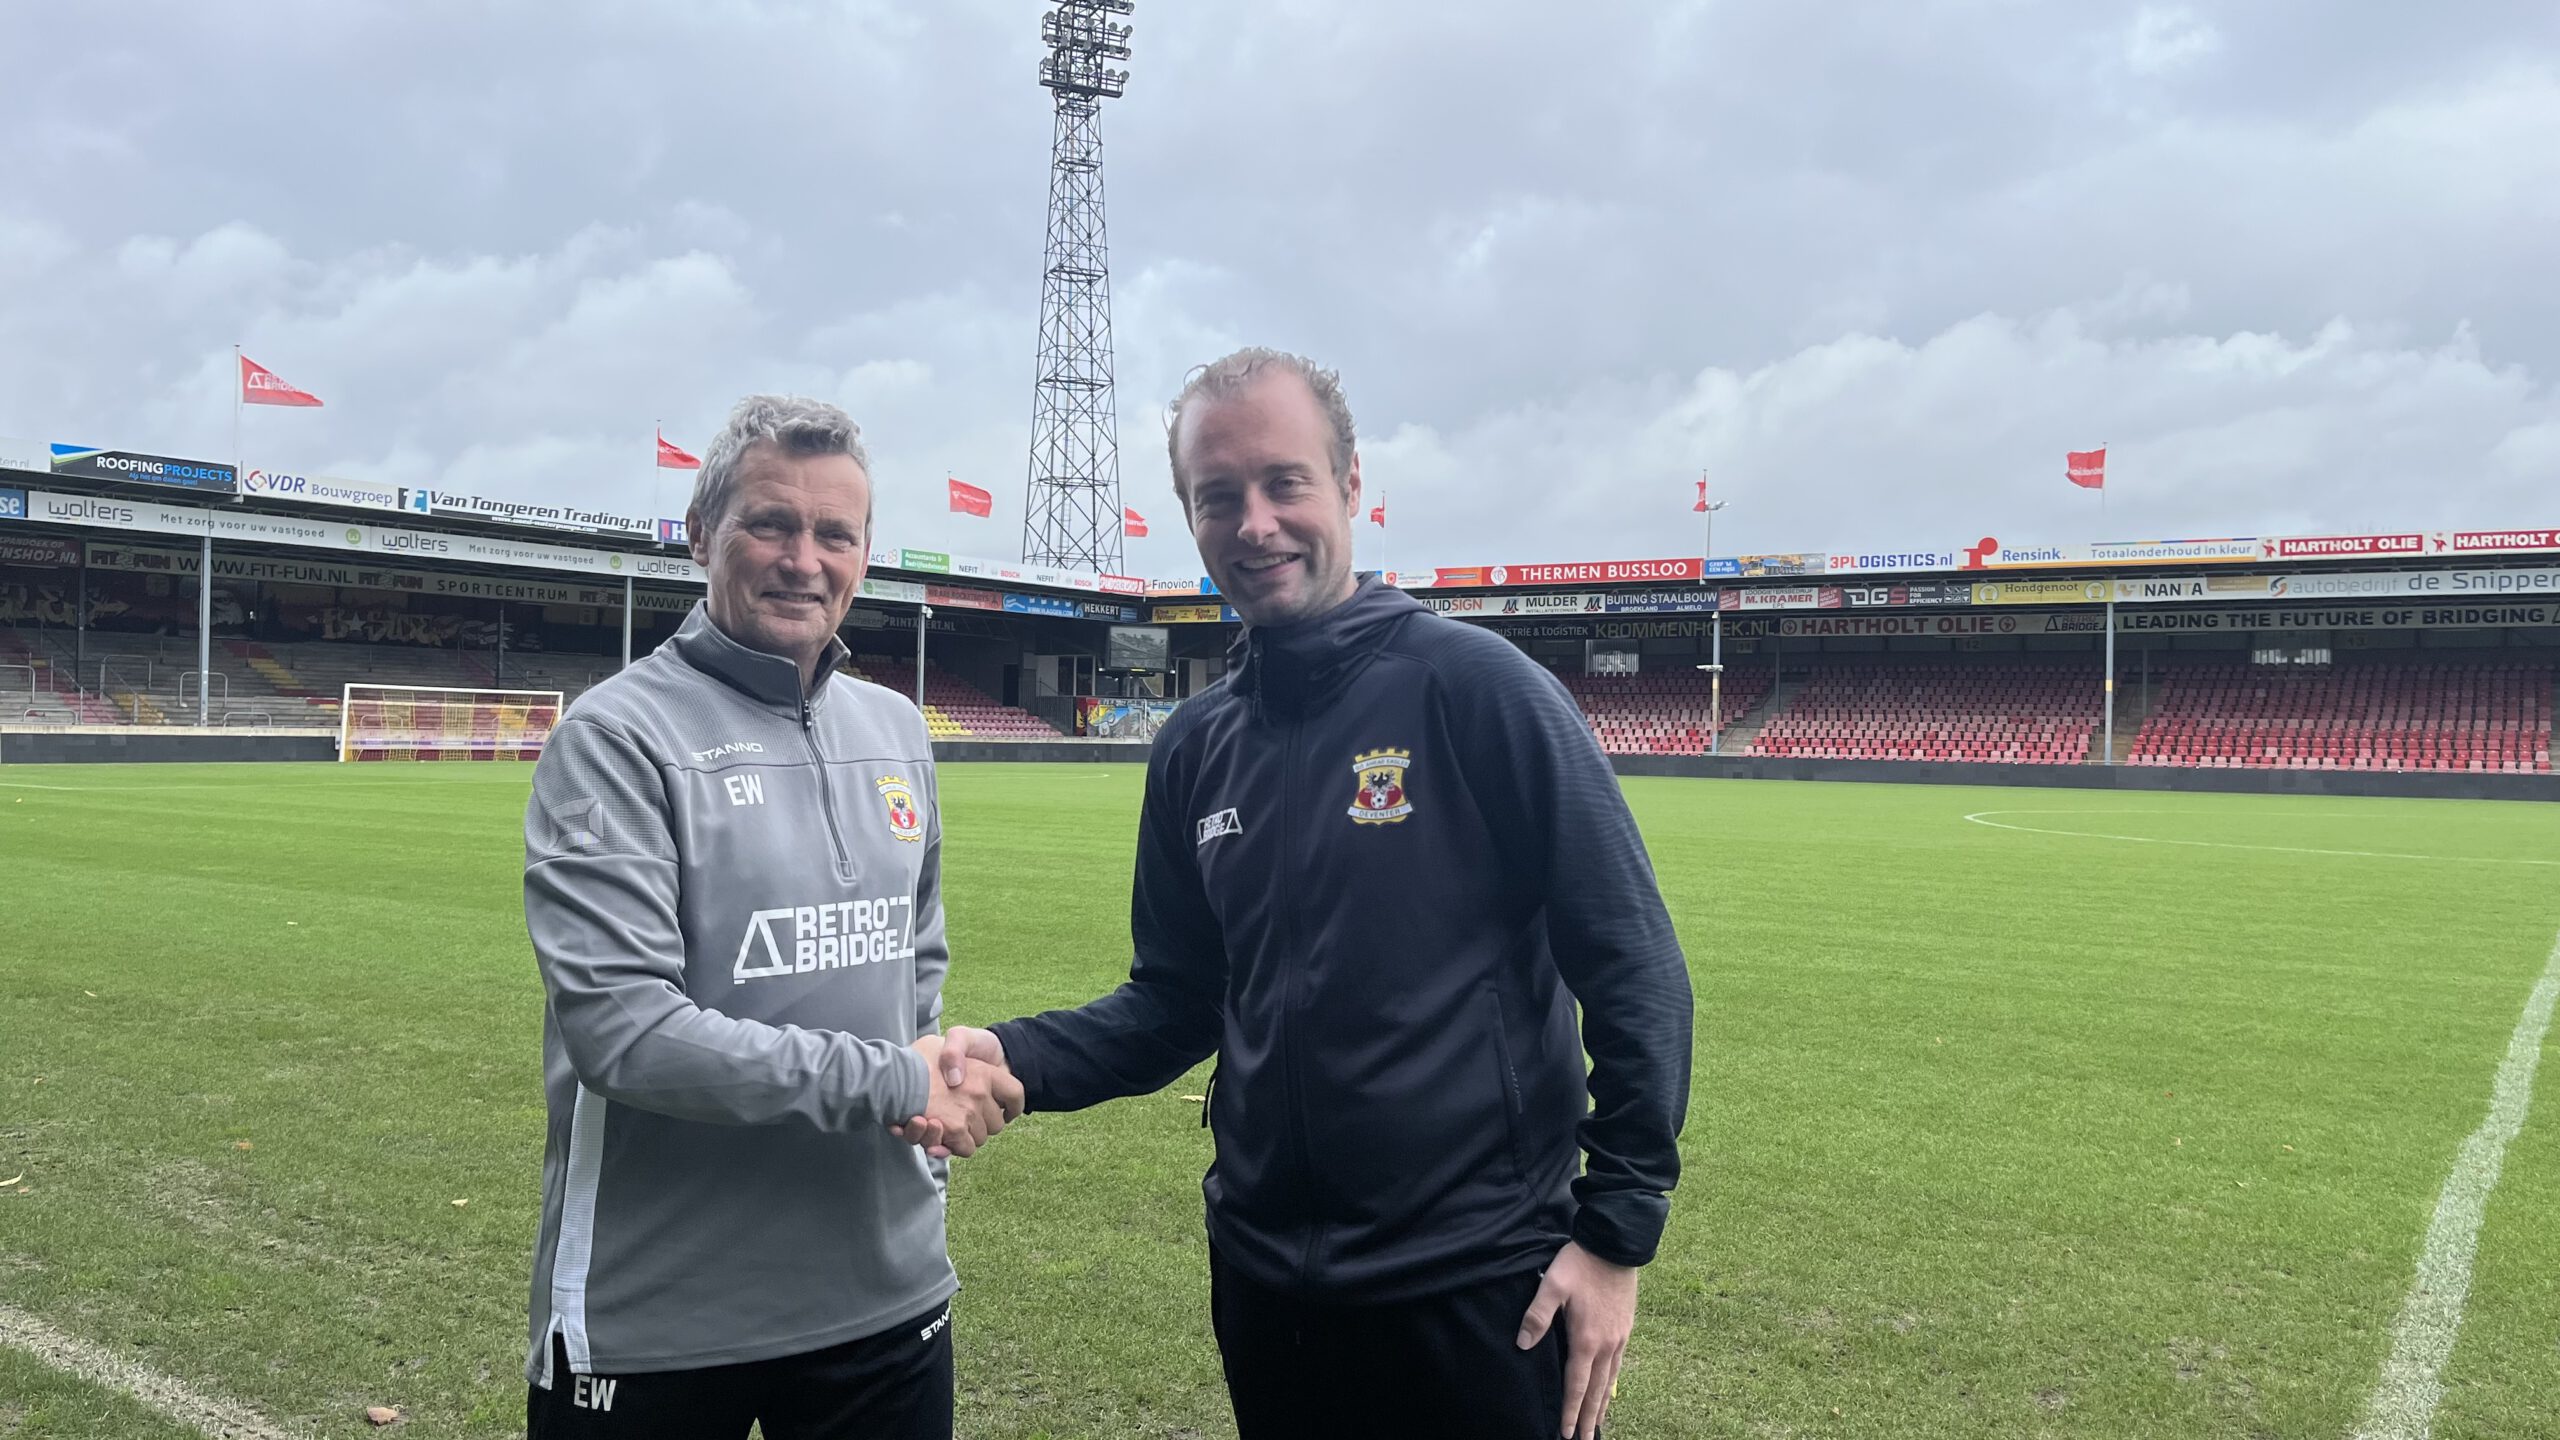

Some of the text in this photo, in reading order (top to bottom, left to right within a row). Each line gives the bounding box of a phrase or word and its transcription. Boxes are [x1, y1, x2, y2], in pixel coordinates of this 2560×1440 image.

[96, 455, 233, 482] ROOFINGPROJECTS
[268, 473, 393, 507] VDR Bouwgroep
[48, 499, 134, 522] wolters
[430, 490, 653, 531] Van Tongeren Trading.nl
[160, 512, 325, 539] Met zorg voor uw vastgoed
[382, 533, 449, 552] wolters
[2283, 536, 2418, 554] HARTHOLT OLIE
[2456, 533, 2550, 548] HARTHOLT
[469, 544, 594, 566] Met zorg voor uw vastgoed
[1830, 553, 1952, 569] 3PLOGISTICS.nl
[2091, 544, 2252, 560] Totaalonderhoud in kleur
[637, 560, 690, 576] wolters
[958, 564, 979, 574] NEFIT
[1520, 561, 1687, 581] THERMEN BUSSLOO
[1036, 574, 1054, 583] NEFIT
[1152, 578, 1194, 590] Finovion
[2291, 577, 2399, 595] autobedrijf
[2408, 573, 2440, 591] de
[437, 579, 568, 601] SPORTCENTRUM
[2005, 582, 2078, 594] Hondgenoot
[1526, 596, 1577, 607] MULDER
[1607, 591, 1718, 605] BUITING STAALBOUW
[1745, 594, 1812, 604] M. KRAMER
[1084, 602, 1120, 615] HEKKERT
[884, 615, 956, 631] PRINTXERT.NL
[1801, 616, 1995, 635] HARTHOLT OLIE
[2061, 622, 2099, 632] BRIDGE
[2062, 615, 2097, 623] RETRO
[2122, 608, 2545, 630] LEADING THE FUTURE OF BRIDGING
[1542, 626, 1589, 636] LOGISTIEK
[1595, 620, 1775, 638] KROMMENHOEK.NL
[691, 742, 764, 762] STANNO
[723, 774, 765, 806] EW
[1358, 808, 1401, 818] DEVENTER
[795, 897, 890, 940] RETRO
[795, 928, 899, 974] BRIDGE
[573, 1374, 617, 1412] EW
